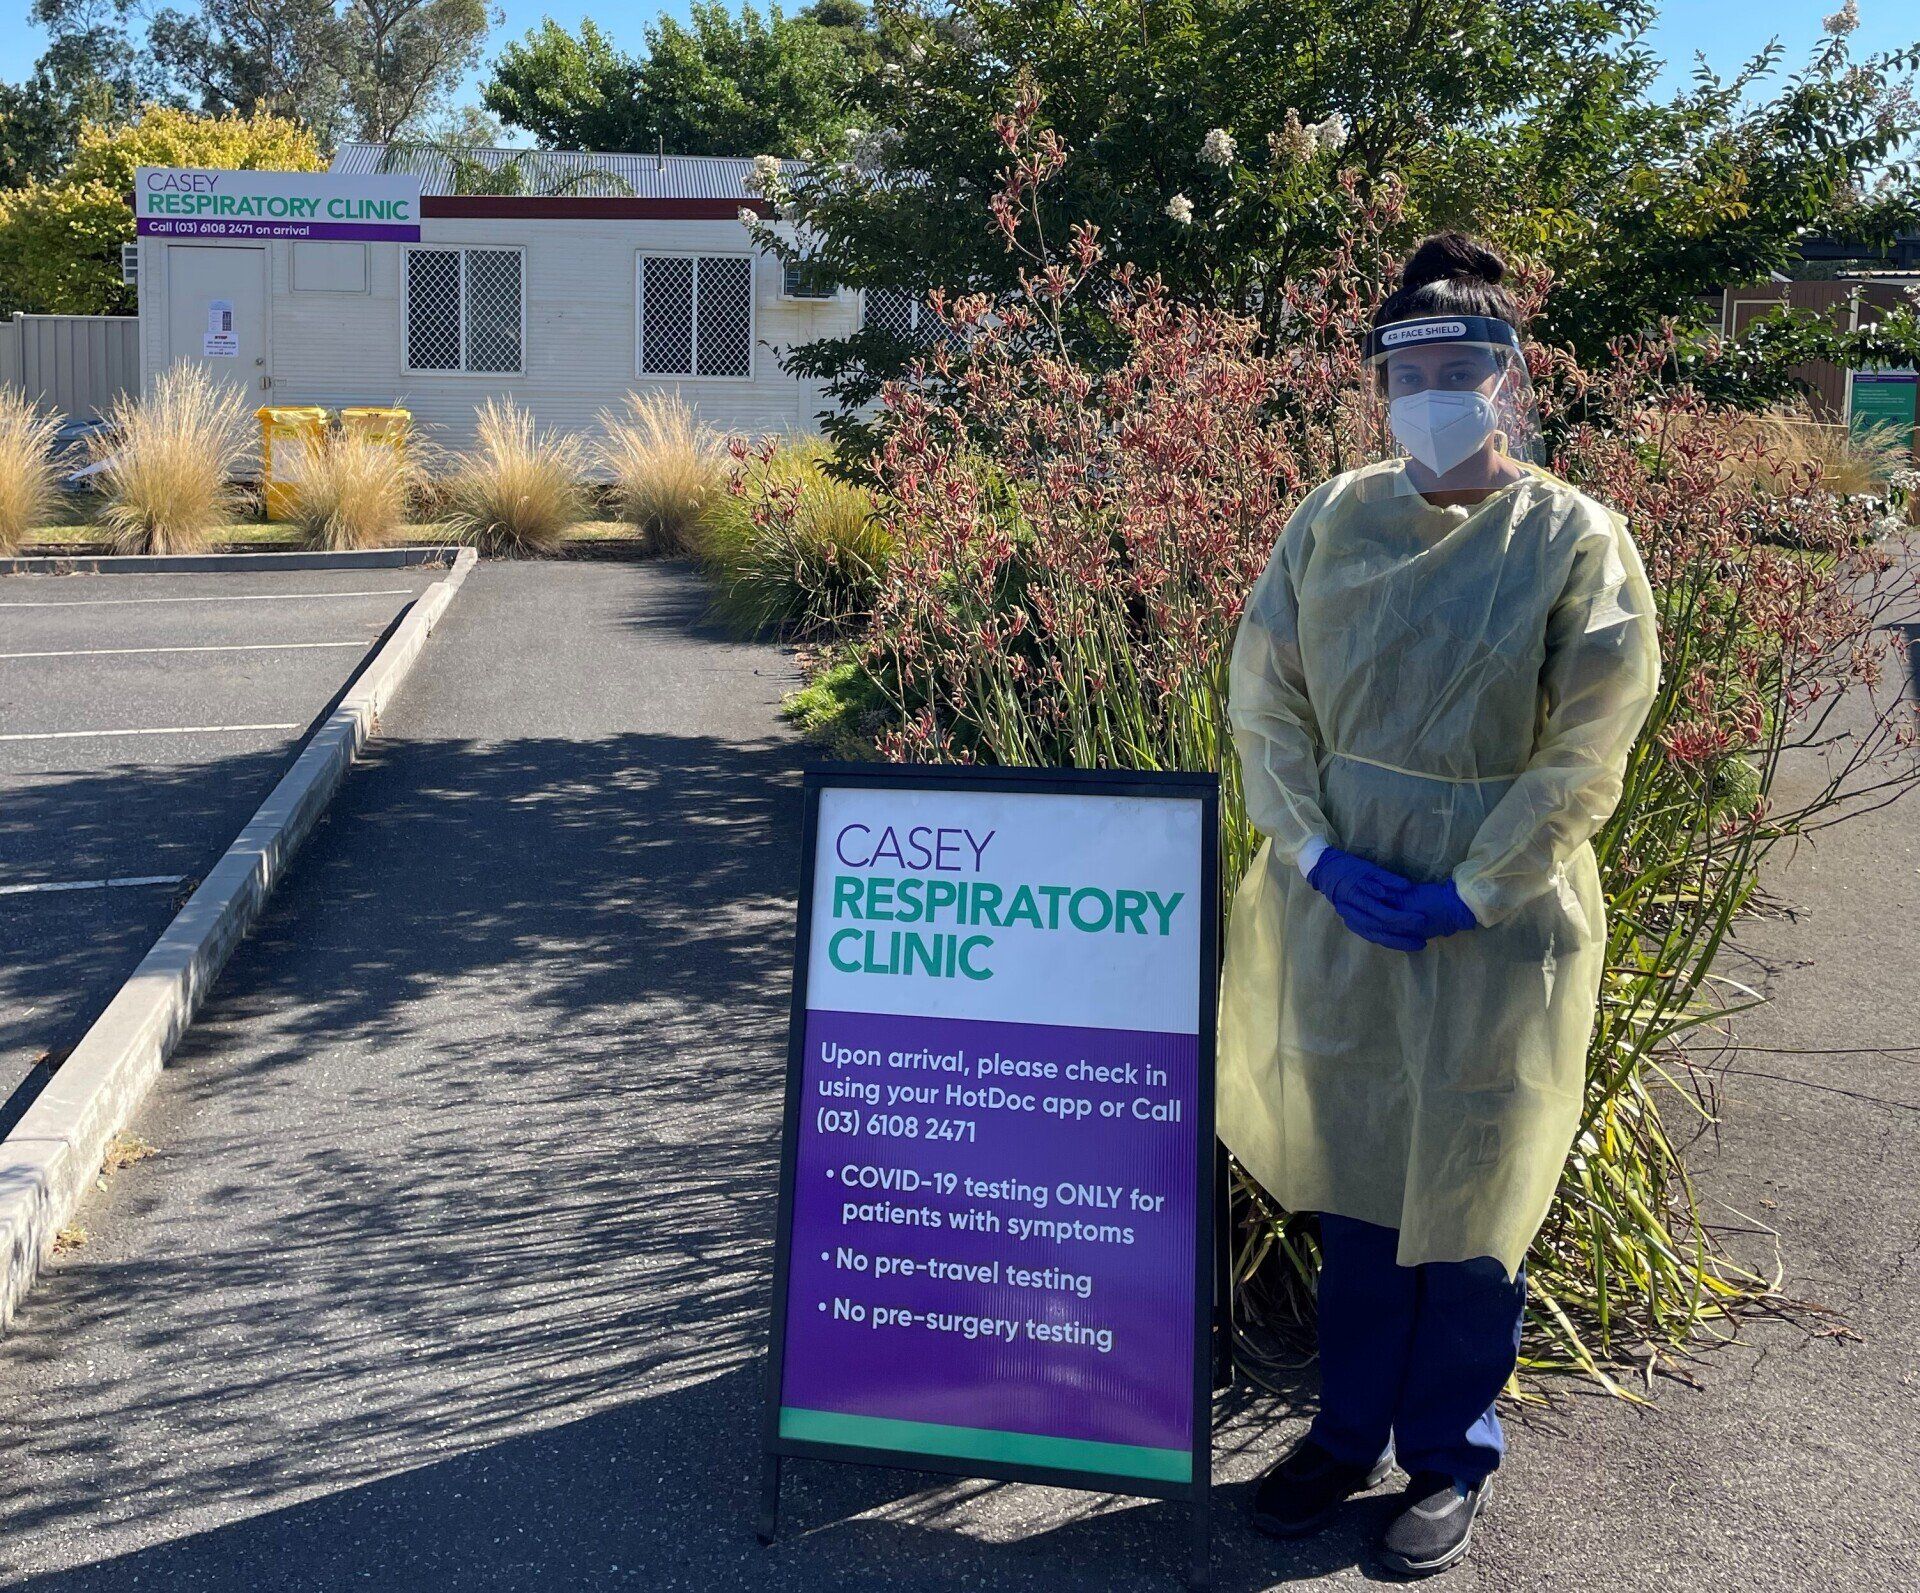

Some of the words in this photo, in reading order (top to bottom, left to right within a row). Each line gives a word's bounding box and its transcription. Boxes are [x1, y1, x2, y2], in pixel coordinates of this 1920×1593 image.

[147, 173, 219, 192] CASEY
[148, 193, 321, 218] RESPIRATORY
[327, 198, 410, 220] CLINIC
[149, 221, 172, 233] Call
[175, 221, 197, 234] (03)
[200, 222, 226, 234] 6108
[228, 223, 253, 235] 2471
[256, 227, 271, 235] on
[273, 225, 310, 236] arrival
[1401, 329, 1424, 339] FACE
[1425, 325, 1460, 335] SHIELD
[836, 823, 996, 872] CASEY
[832, 875, 1185, 936] RESPIRATORY
[828, 927, 994, 981] CLINIC
[821, 1041, 881, 1069] Upon
[888, 1048, 970, 1076] arrival,
[977, 1052, 1058, 1079] please
[1065, 1058, 1138, 1085] check
[1146, 1064, 1167, 1087] in
[818, 1076, 880, 1106] using
[887, 1085, 939, 1107] your
[946, 1085, 1036, 1112] HotDoc
[1043, 1098, 1092, 1120] app
[1099, 1099, 1125, 1118] or
[1131, 1097, 1182, 1123] Call
[816, 1107, 860, 1136] (03)
[866, 1114, 919, 1139] 6108
[925, 1118, 977, 1143] 2471
[840, 1164, 958, 1195] COVID-19
[964, 1176, 1049, 1208] testing
[1055, 1182, 1124, 1209] ONLY
[1129, 1188, 1165, 1213] for
[842, 1200, 942, 1228] patients
[948, 1207, 1000, 1233] with
[1007, 1218, 1135, 1245] symptoms
[836, 1247, 869, 1272] No
[874, 1253, 999, 1285] pre-travel
[1006, 1264, 1092, 1298] testing
[833, 1298, 866, 1322] No
[872, 1304, 1019, 1342] pre-surgery
[1026, 1319, 1113, 1353] testing
